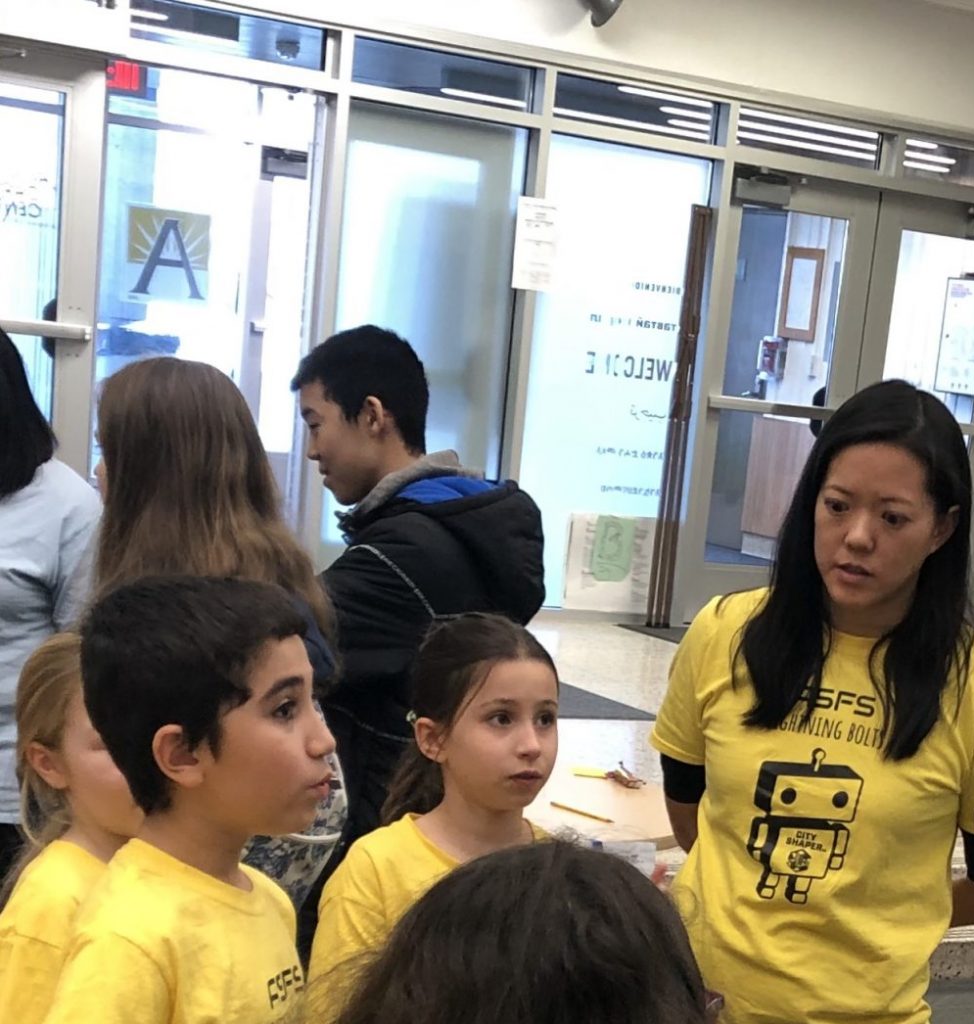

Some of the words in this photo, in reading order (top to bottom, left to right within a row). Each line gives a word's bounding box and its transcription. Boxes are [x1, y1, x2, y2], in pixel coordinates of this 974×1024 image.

[128, 218, 205, 300] A
[801, 688, 876, 717] SFS
[796, 830, 817, 841] CITY
